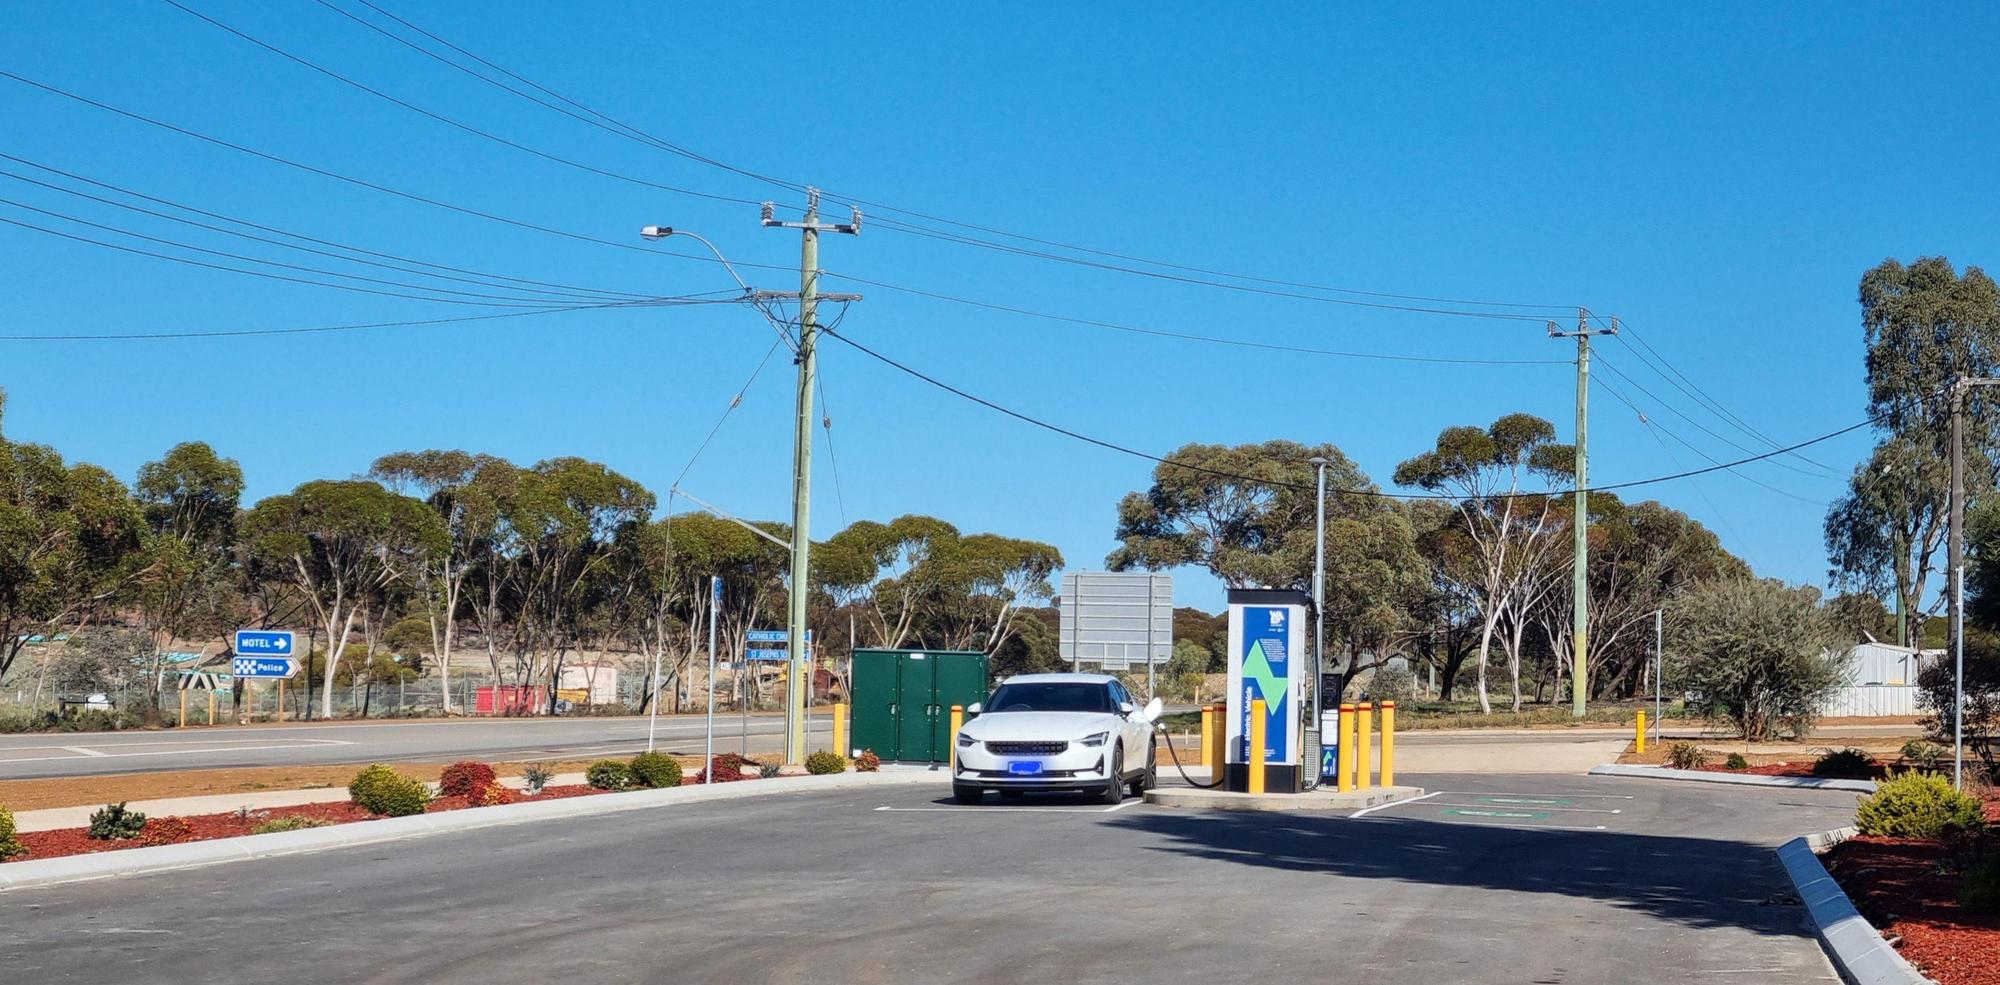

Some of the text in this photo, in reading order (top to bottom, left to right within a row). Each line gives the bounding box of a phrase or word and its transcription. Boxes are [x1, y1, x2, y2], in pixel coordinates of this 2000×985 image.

[748, 632, 775, 640] CATHOLIC
[241, 638, 271, 648] MOTEL
[257, 663, 284, 672] Police
